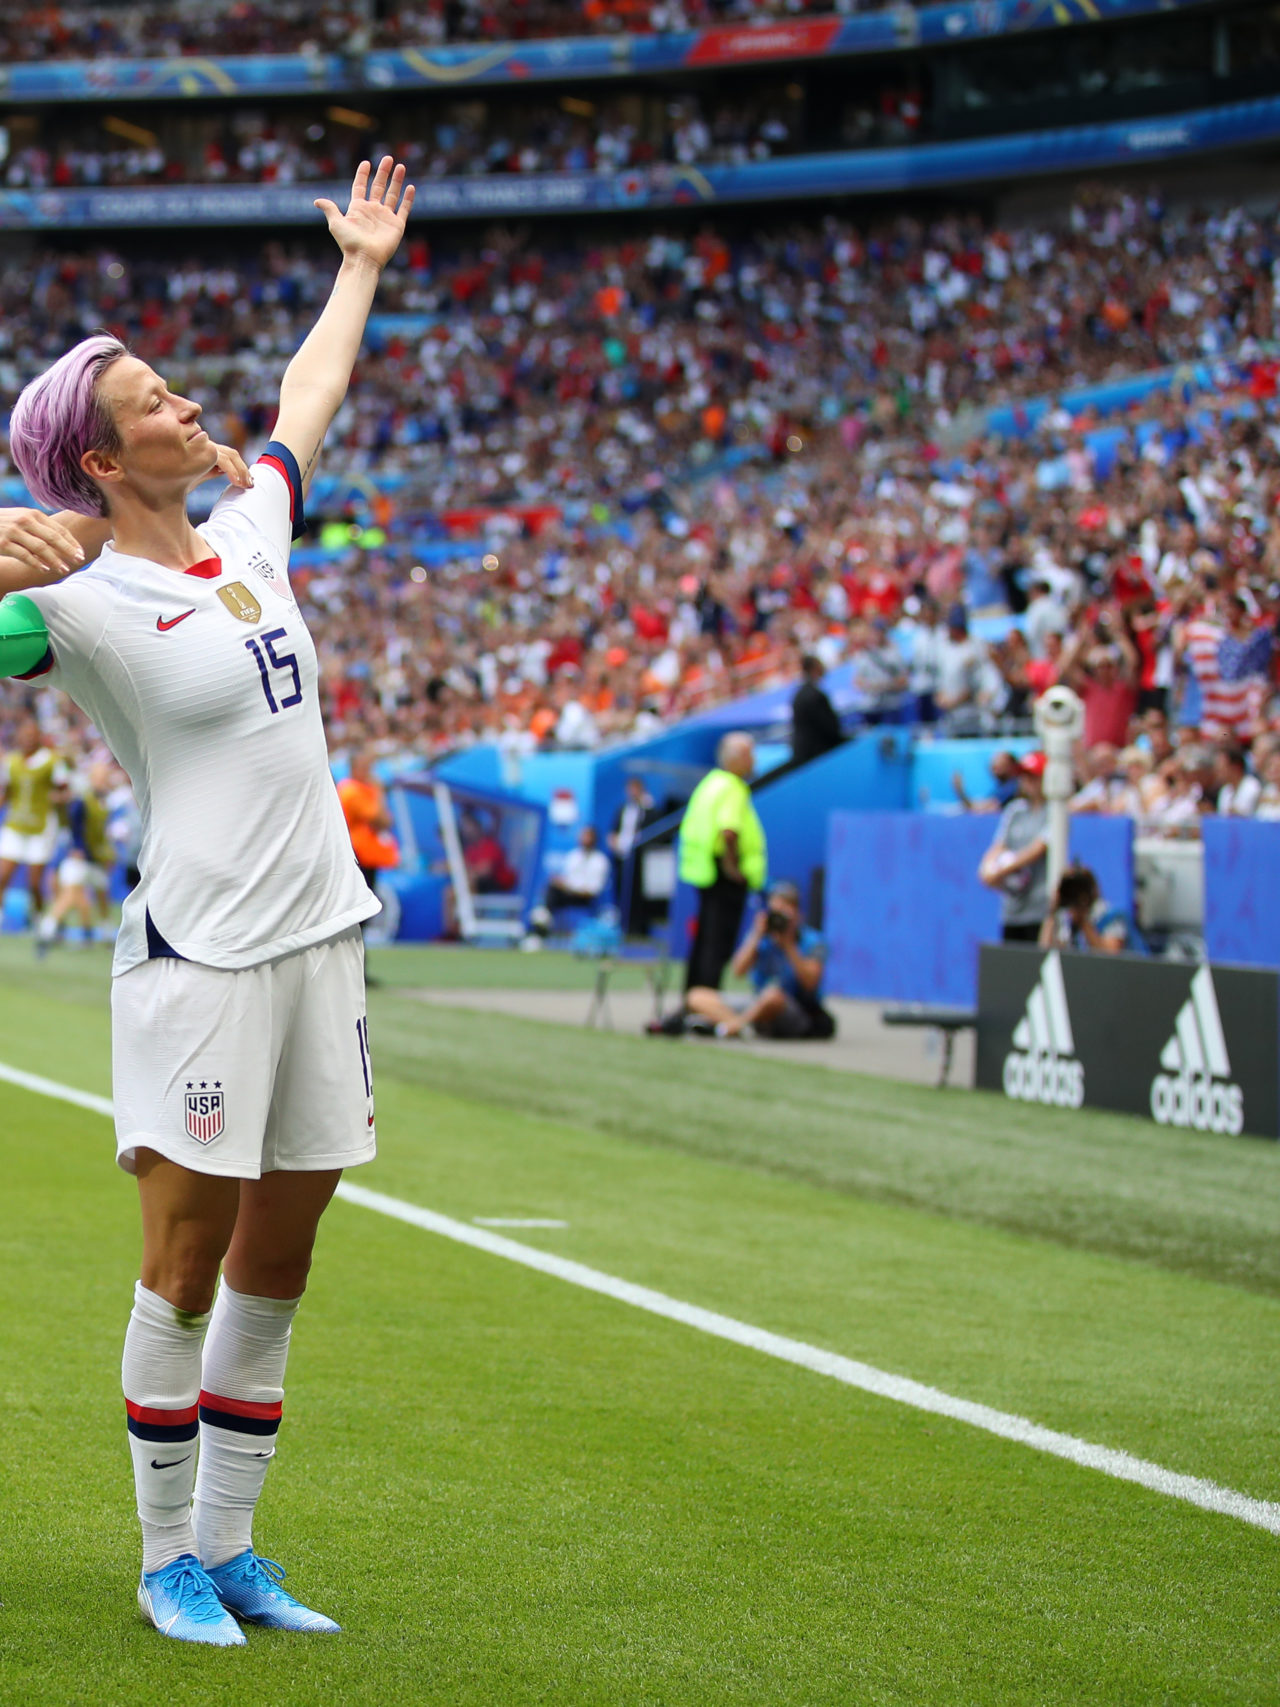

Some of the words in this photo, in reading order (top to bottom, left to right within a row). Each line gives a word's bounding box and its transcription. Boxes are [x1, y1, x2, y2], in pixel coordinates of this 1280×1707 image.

[245, 627, 303, 714] 15
[188, 1096, 220, 1115] USA
[1003, 1049, 1085, 1110] adidas
[1150, 1071, 1244, 1136] adidas
